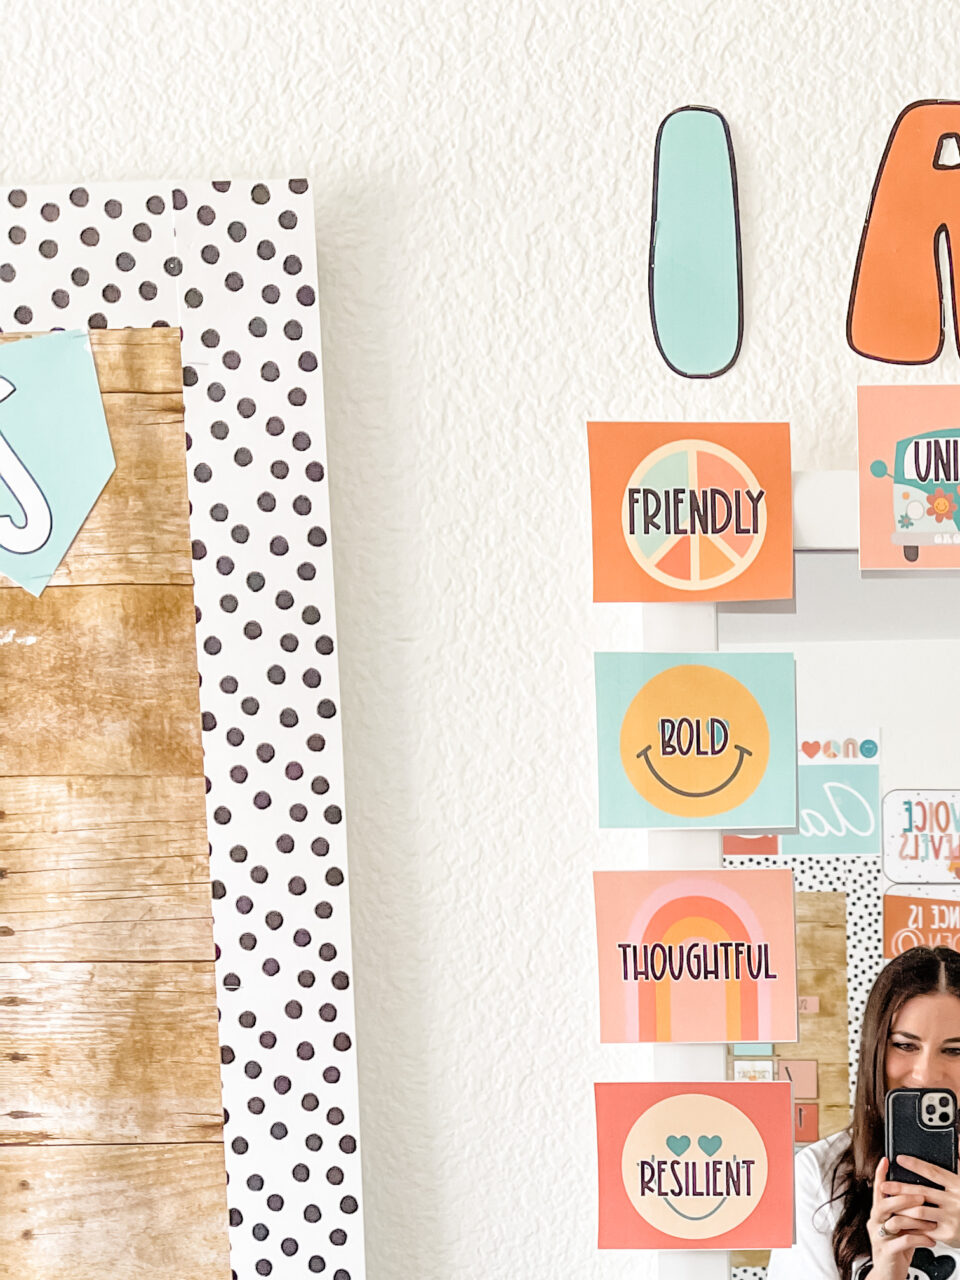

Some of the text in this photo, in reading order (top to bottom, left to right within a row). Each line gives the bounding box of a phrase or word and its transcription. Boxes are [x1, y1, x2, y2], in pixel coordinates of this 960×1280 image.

[649, 105, 743, 378] I
[628, 488, 765, 534] FRIENDLY
[660, 718, 728, 756] BOLD
[618, 943, 776, 980] THOUGHTFUL
[640, 1160, 754, 1197] RESILIENT
